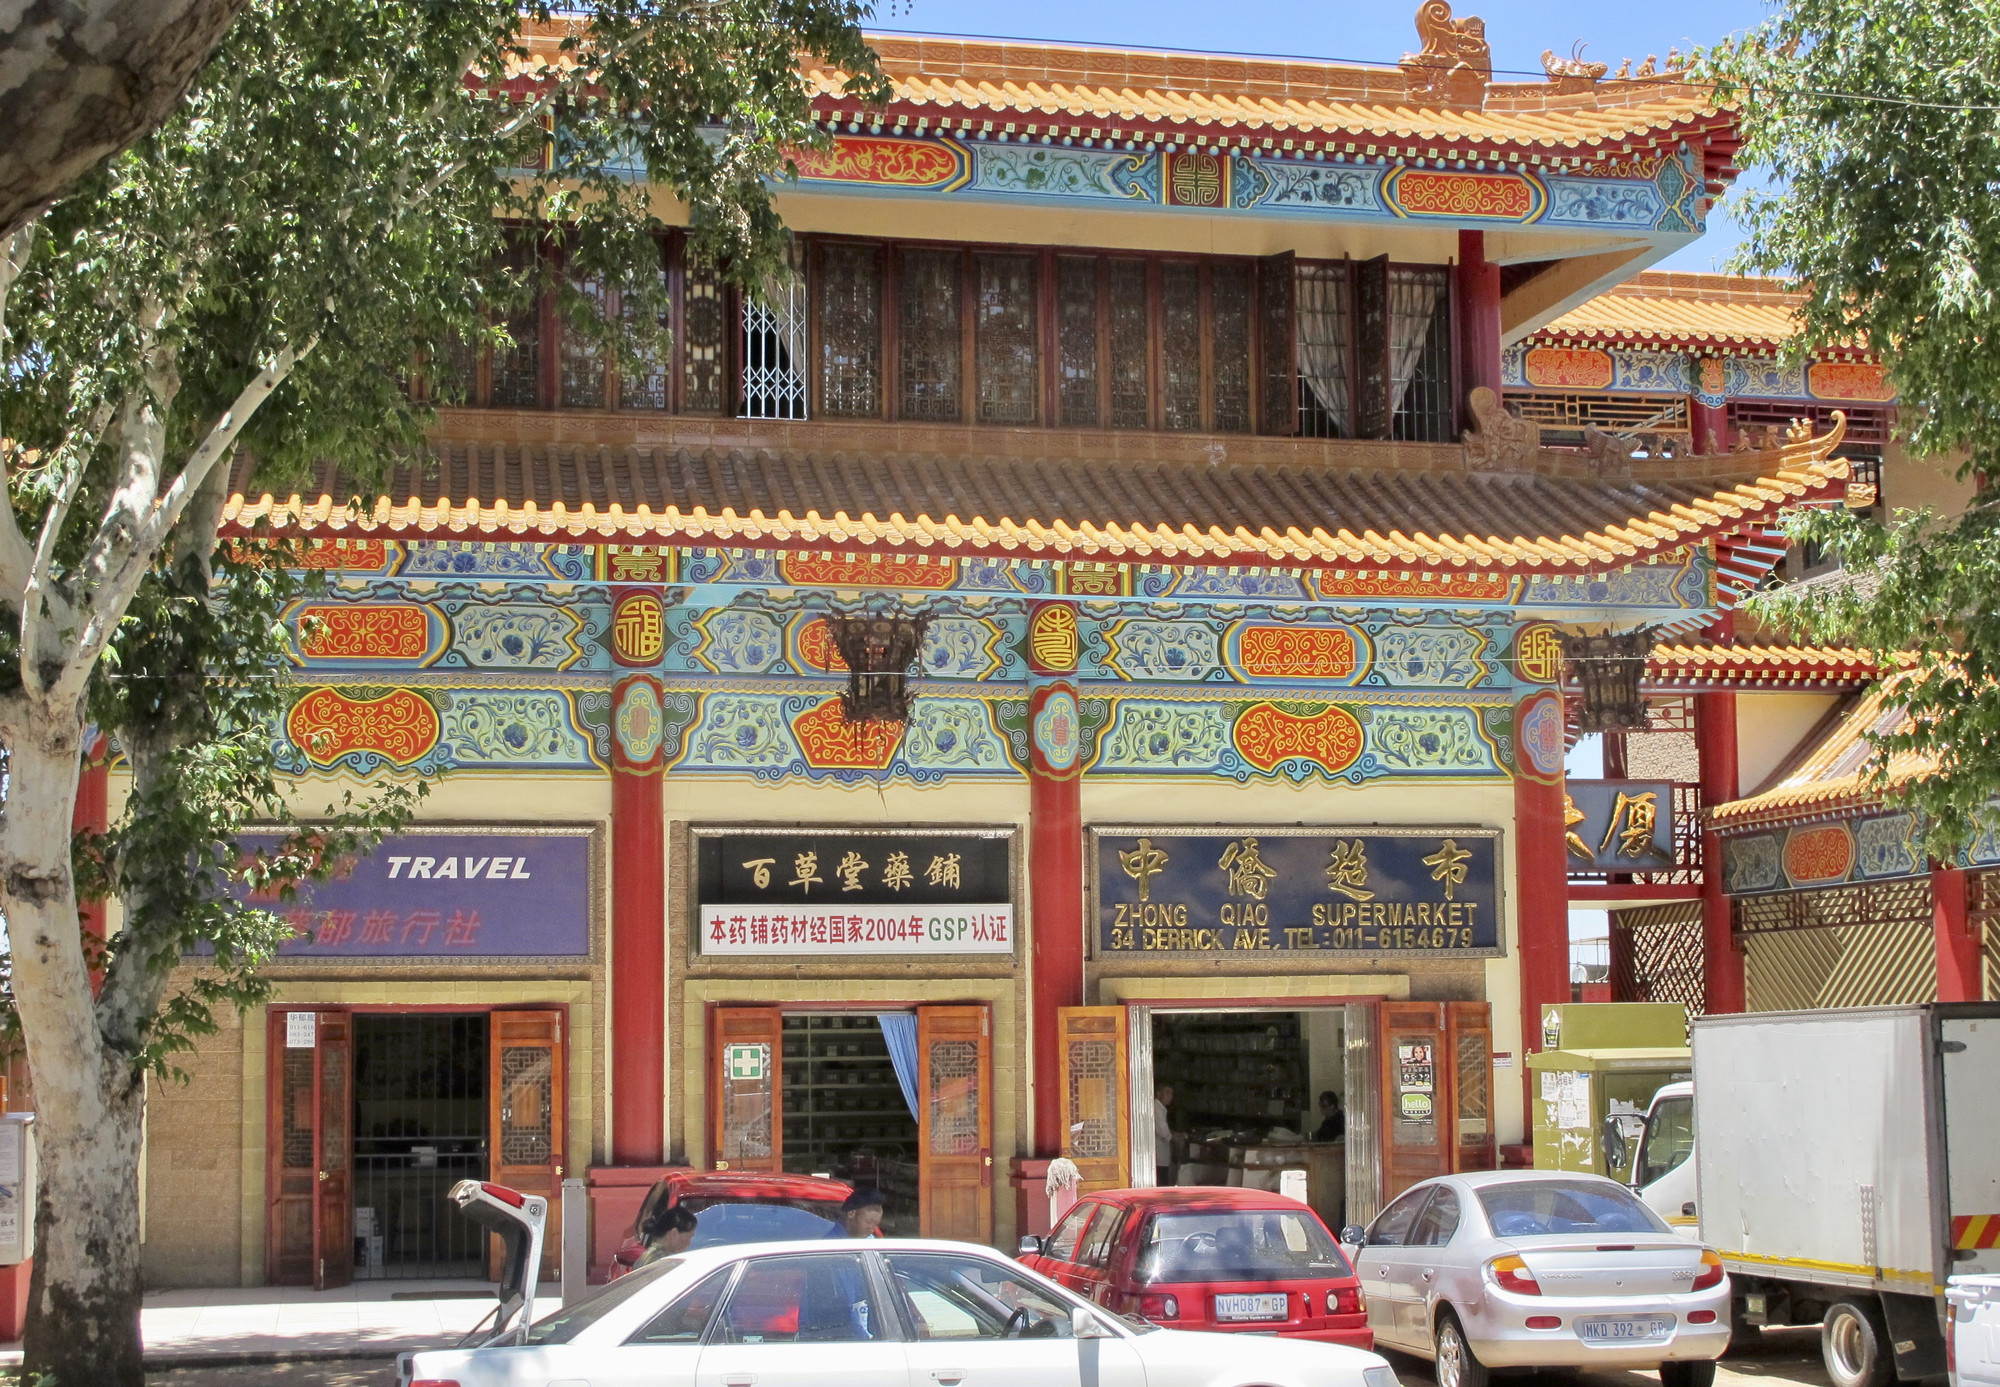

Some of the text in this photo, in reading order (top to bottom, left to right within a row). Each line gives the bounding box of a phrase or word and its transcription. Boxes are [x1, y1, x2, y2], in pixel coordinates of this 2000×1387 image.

[387, 856, 532, 879] TRAVEL
[742, 851, 962, 894] 百草堂藥鋪
[1118, 837, 1473, 902] 中僑超市
[1115, 903, 1478, 927] ZHONG QIAO SUPERMARKET
[1110, 929, 1135, 949] 34
[1143, 929, 1223, 950] DERRICK
[1405, 1099, 1429, 1108] hello
[1218, 1297, 1286, 1312] NVH087 GP
[1585, 1322, 1665, 1338] MKD 392 GP
